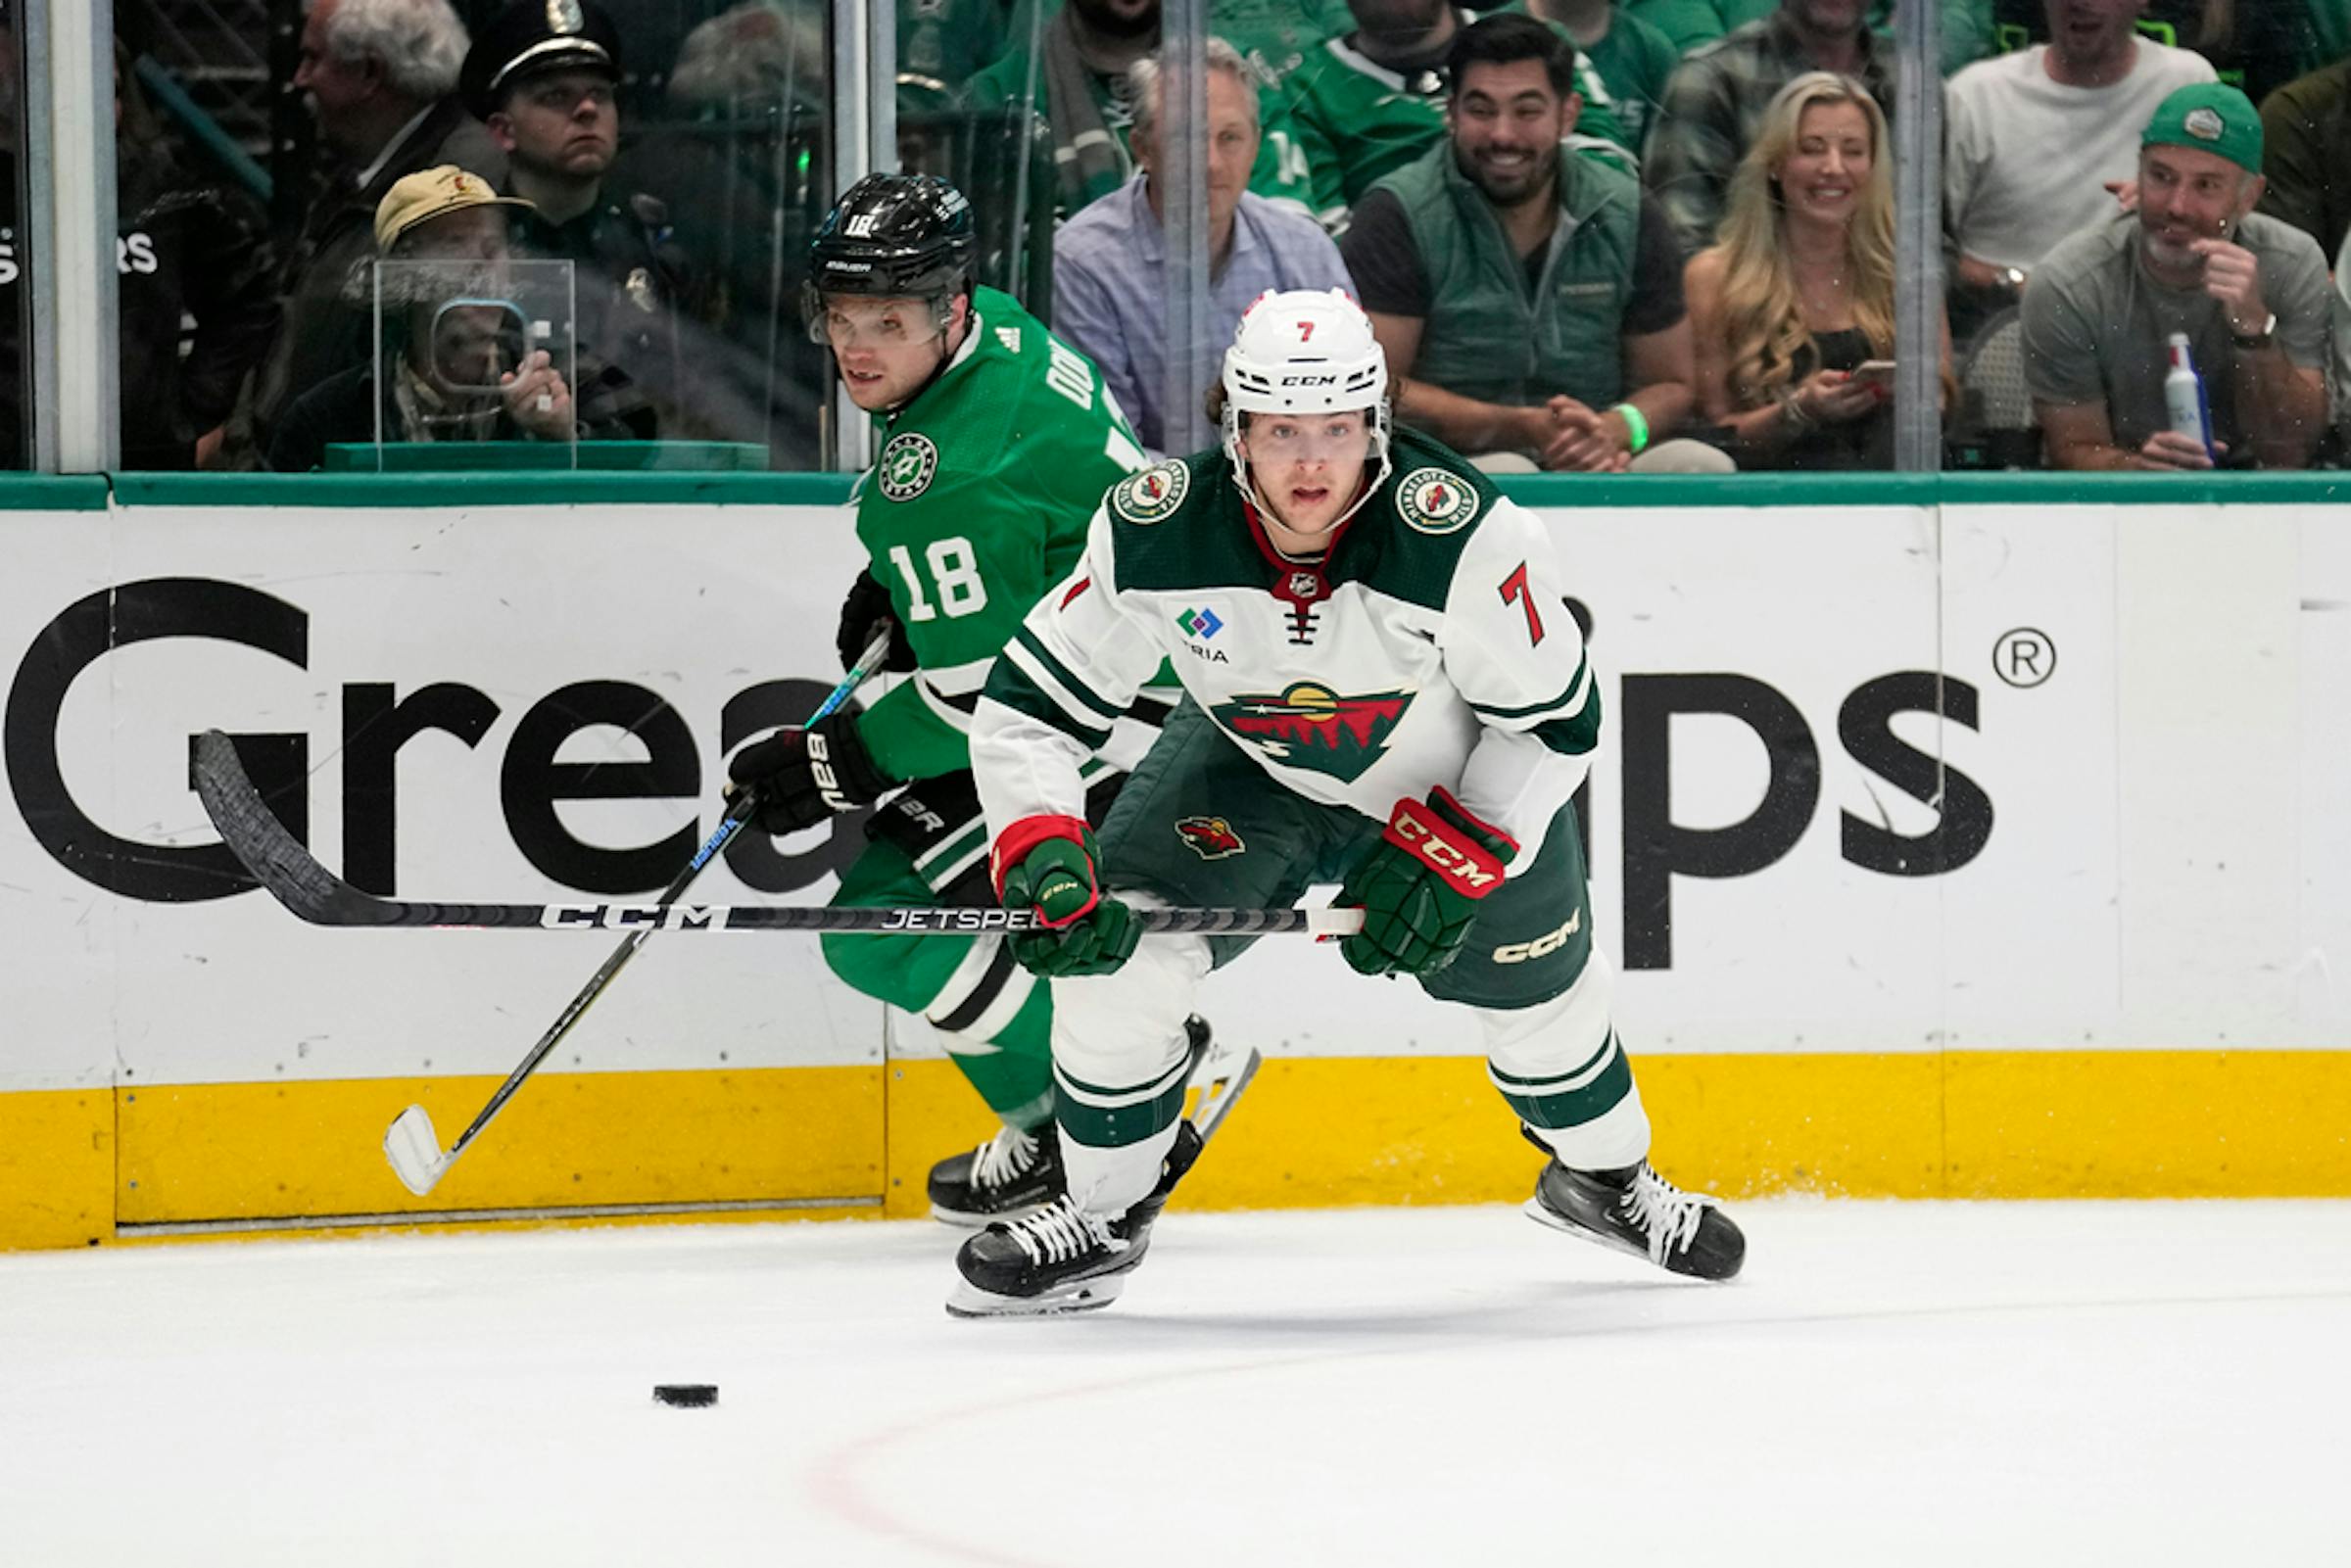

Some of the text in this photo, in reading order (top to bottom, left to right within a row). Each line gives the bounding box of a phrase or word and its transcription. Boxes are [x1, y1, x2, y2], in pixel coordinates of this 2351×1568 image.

[1297, 321, 1315, 342] 7
[1281, 375, 1336, 387] CCM
[888, 537, 988, 622] 18
[1499, 561, 1545, 647] 7
[4, 576, 877, 903] Grea
[806, 732, 863, 813] BAU
[1385, 801, 1505, 891] CCM
[540, 903, 733, 931] CCM
[1493, 907, 1582, 965] CCM
